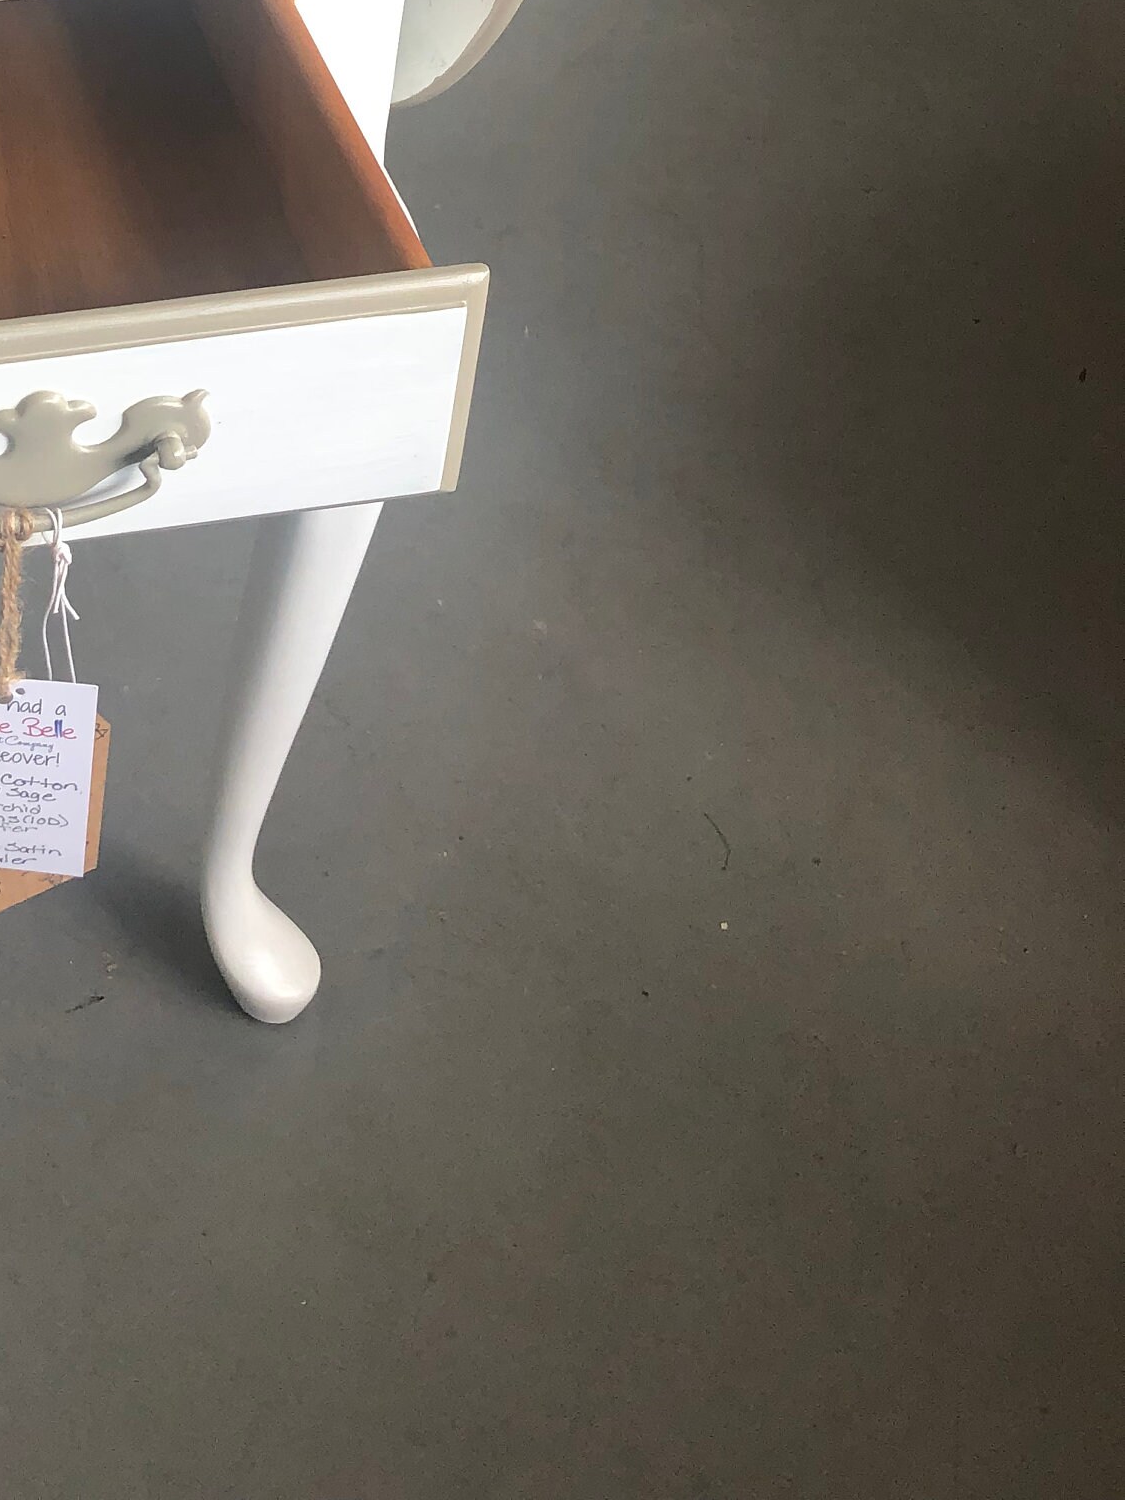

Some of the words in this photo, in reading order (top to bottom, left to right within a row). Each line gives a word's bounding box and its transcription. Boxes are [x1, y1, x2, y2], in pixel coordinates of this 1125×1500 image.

[6, 698, 43, 715] had
[55, 704, 67, 717] a
[21, 717, 77, 740] Belle
[6, 788, 57, 803] Sage
[4, 842, 62, 856] Satin
